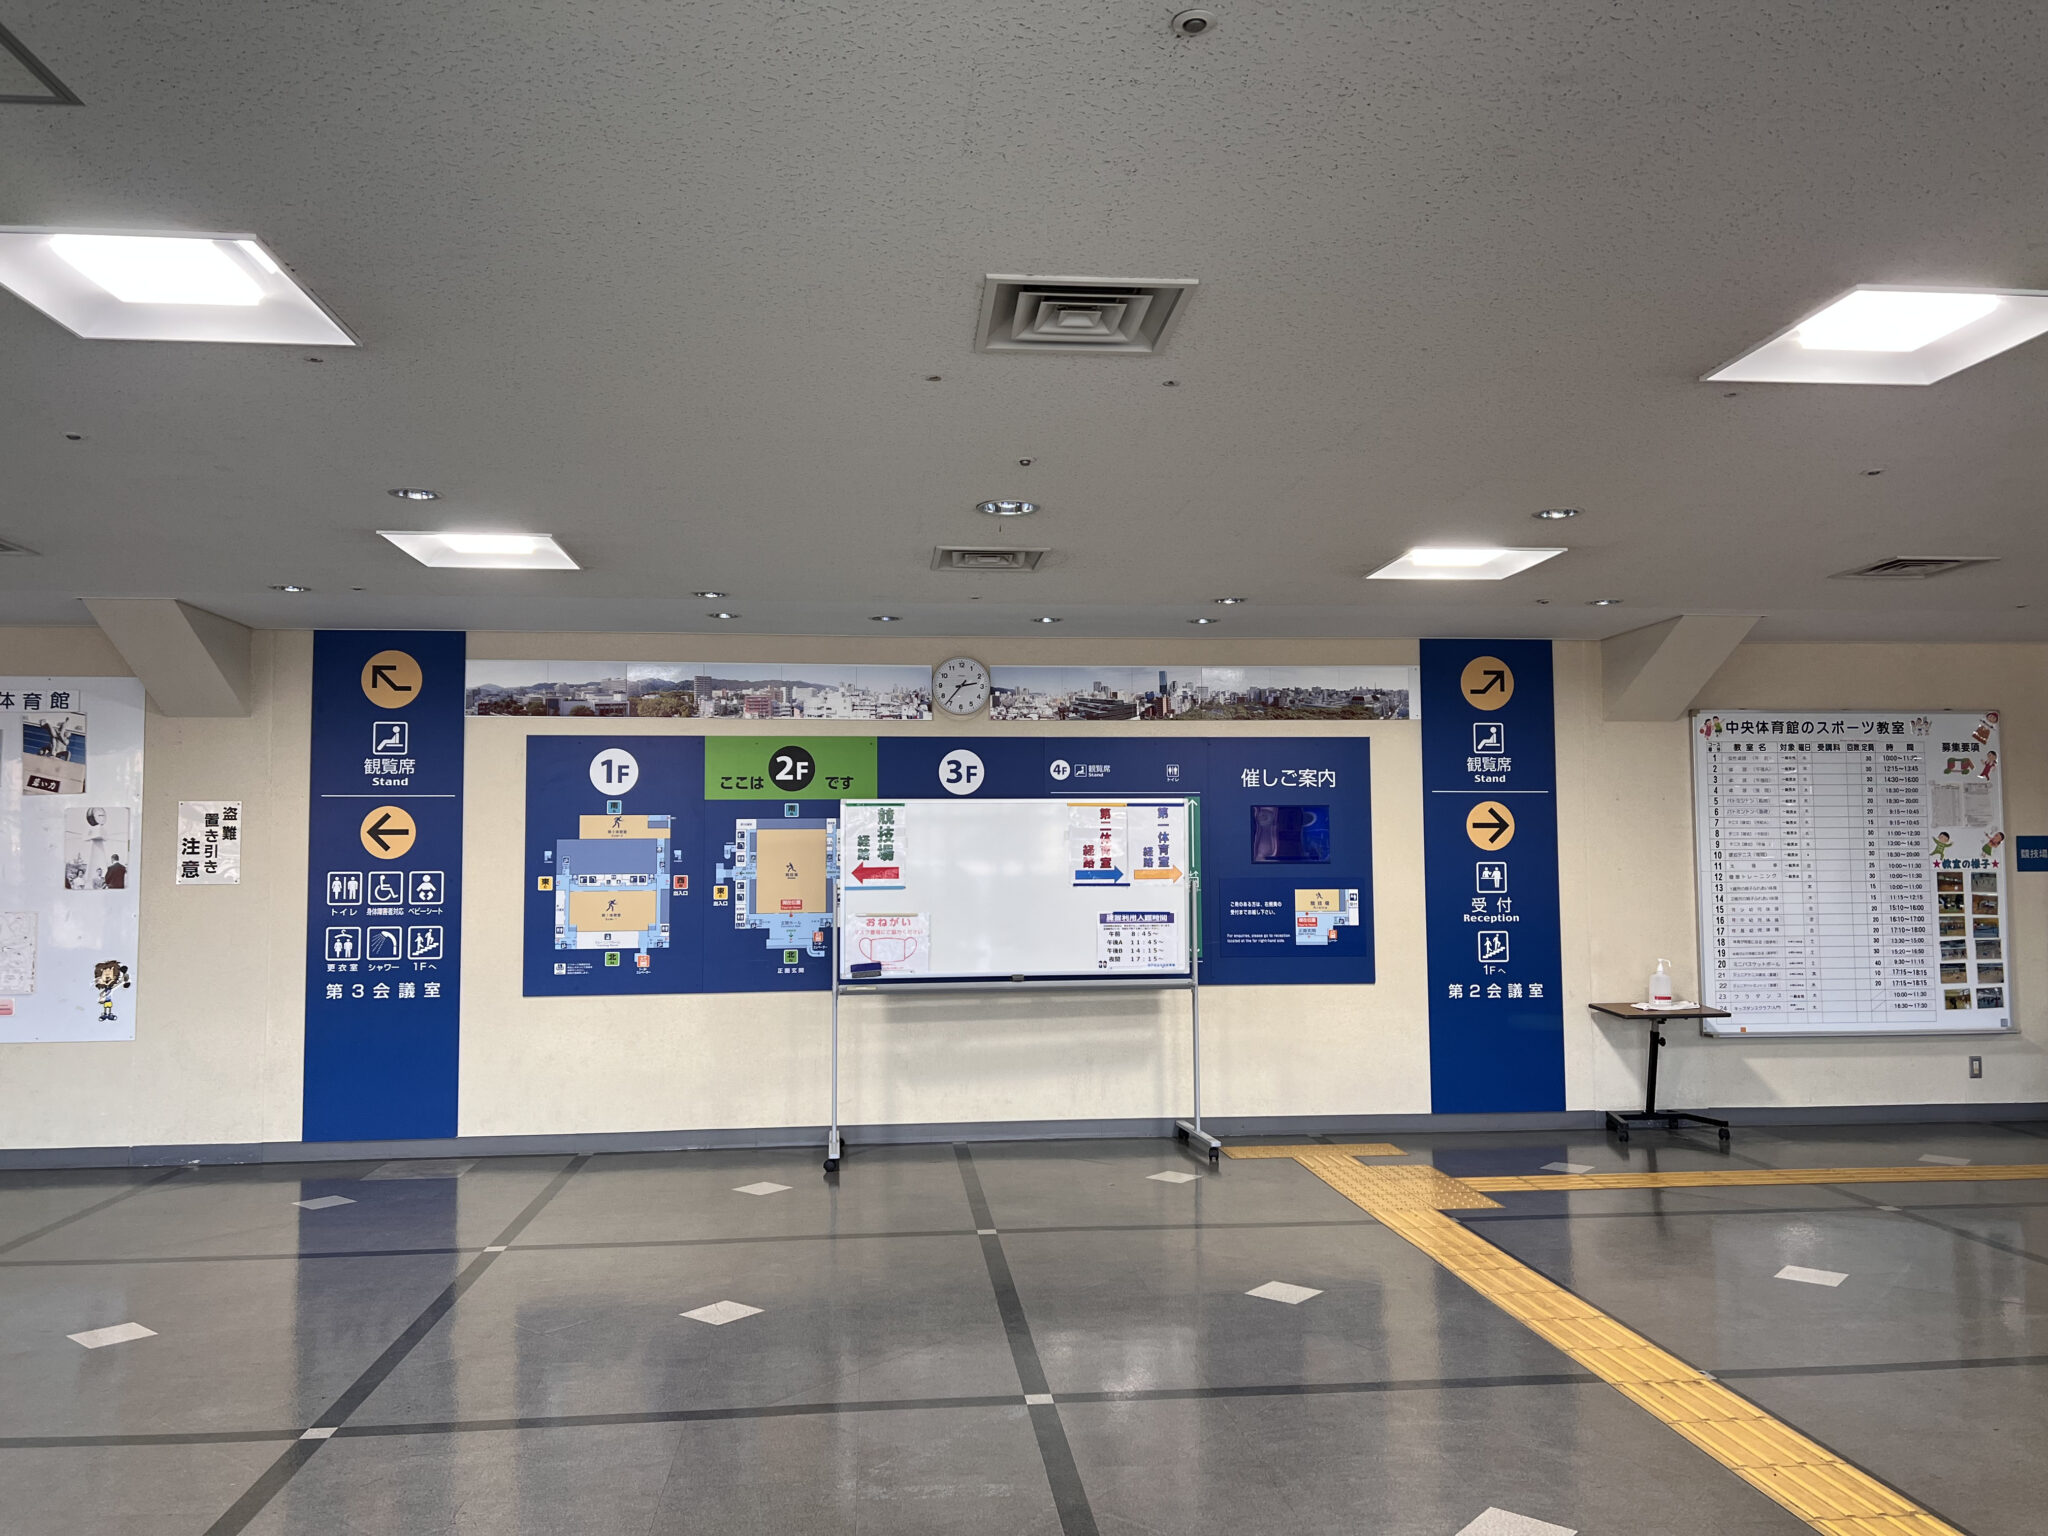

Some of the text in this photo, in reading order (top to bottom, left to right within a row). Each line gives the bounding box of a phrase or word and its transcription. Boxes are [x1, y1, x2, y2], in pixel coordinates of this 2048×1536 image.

[0, 691, 70, 710] 体育館
[1725, 720, 1905, 735] 中央体育館のスポーツ教室
[1733, 743, 1766, 752] 教室名
[1779, 743, 1795, 752] 対象
[364, 758, 416, 775] 観覧席
[1466, 757, 1512, 772] 観覧席
[1713, 765, 1717, 773] 2
[601, 759, 630, 784] 1F
[720, 755, 854, 790] ここは 2F です
[946, 760, 978, 784] 3F
[1052, 764, 1068, 776] 4F
[372, 777, 409, 787] Stand
[1240, 768, 1336, 788] 催しご案内
[1474, 775, 1506, 783] Stand
[1713, 776, 1718, 784] 3
[1714, 797, 1718, 805] 5
[1714, 808, 1719, 816] 6
[222, 806, 238, 841] 盗難
[1714, 819, 1719, 827] 7
[877, 807, 895, 862] 競技場
[1157, 807, 1170, 868] 第一体育室
[1715, 829, 1720, 838] 8
[204, 812, 219, 874] 置き引き
[857, 834, 871, 861] 経路
[181, 837, 201, 879] 注意
[1714, 851, 1722, 859] 10
[1714, 862, 1722, 870] 11
[1714, 873, 1723, 881] 12
[1471, 897, 1512, 913] 受付
[331, 908, 358, 916] トイレ
[408, 907, 443, 916] ベビーシート
[1716, 906, 1724, 914] 15
[866, 918, 911, 927] おねがい
[1463, 913, 1520, 923] Reception
[1716, 927, 1725, 935] 17
[1717, 938, 1725, 946] 18
[1718, 949, 1726, 957] 19
[326, 963, 359, 972] 更衣室
[368, 963, 400, 972] シャワー
[413, 962, 437, 971] 1Fへ
[1718, 960, 1726, 968] 20
[1483, 965, 1506, 976] 1Fへ
[325, 982, 441, 1000] 第3会議室
[1448, 983, 1544, 999] 第2会議室
